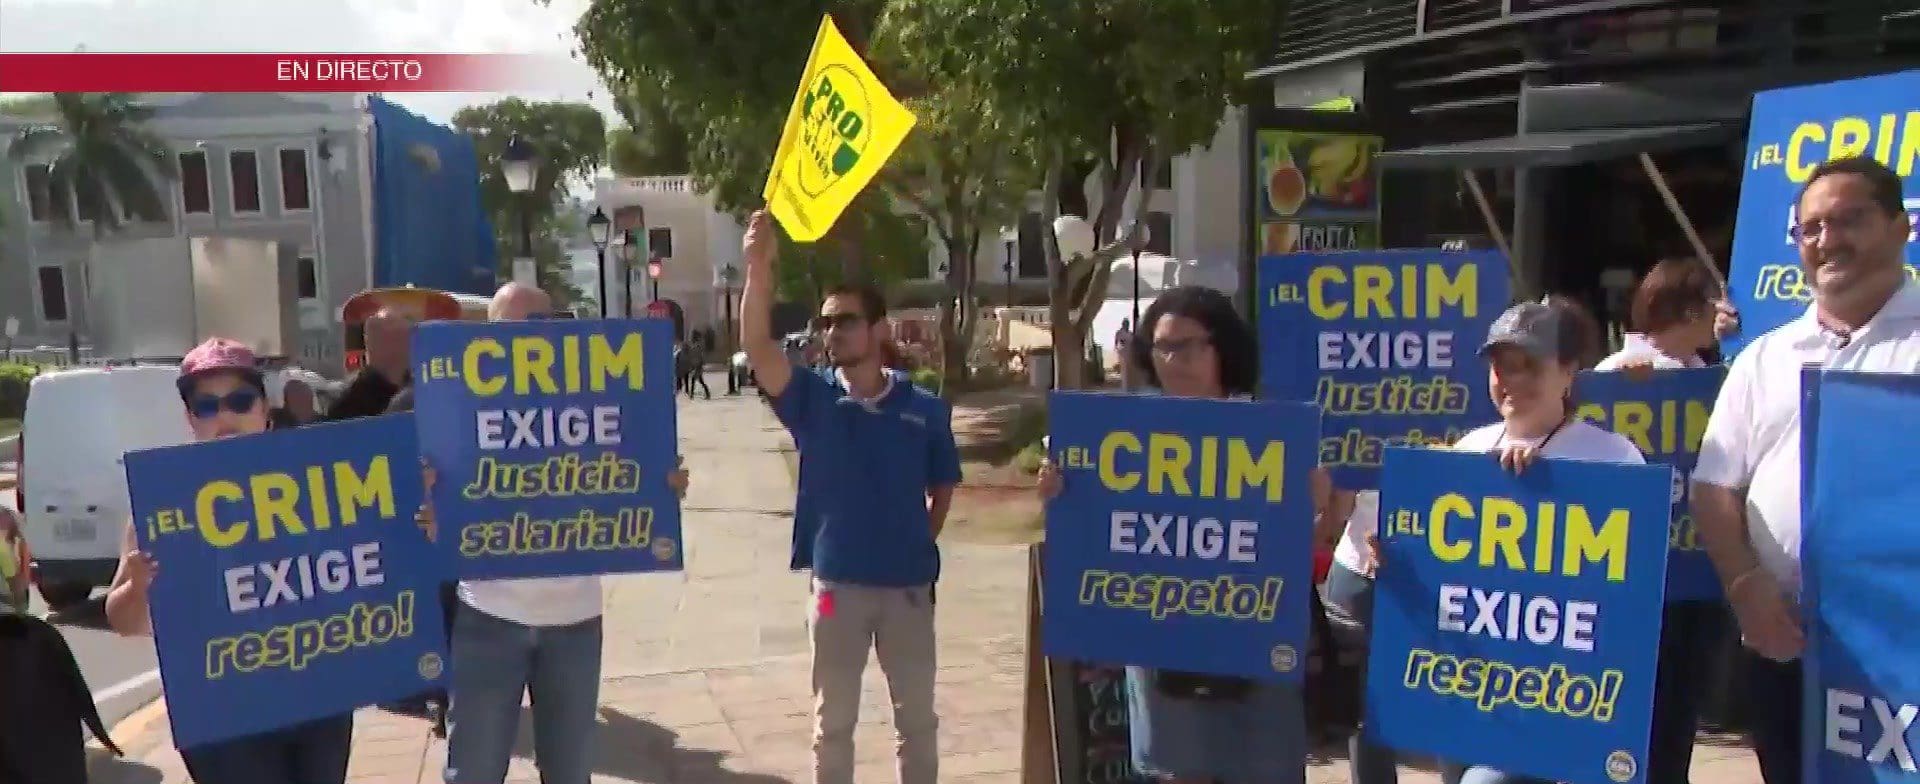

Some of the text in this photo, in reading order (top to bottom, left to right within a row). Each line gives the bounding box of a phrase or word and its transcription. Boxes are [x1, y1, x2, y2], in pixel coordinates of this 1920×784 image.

[816, 75, 864, 142] PRO
[1752, 142, 1784, 170] ¡EL
[1270, 263, 1478, 320] ¡EL CRIM
[422, 331, 645, 397] ¡EL CRIM
[1317, 330, 1454, 370] EXIGE
[477, 405, 622, 449] EXIGE
[464, 451, 641, 499] Justicia
[1099, 431, 1285, 503] CRIM
[147, 455, 396, 548] ¡EL CRIM
[460, 507, 653, 559] salarial!
[1109, 510, 1259, 562] EXIGE
[1387, 509, 1424, 537] ¡EL
[1428, 492, 1630, 582] CRIM
[224, 542, 385, 613] EXIGE
[1079, 569, 1284, 622] respeto!
[205, 590, 415, 680] respeto!
[1437, 583, 1599, 652] EXIGE
[1404, 648, 1624, 722] respeto!
